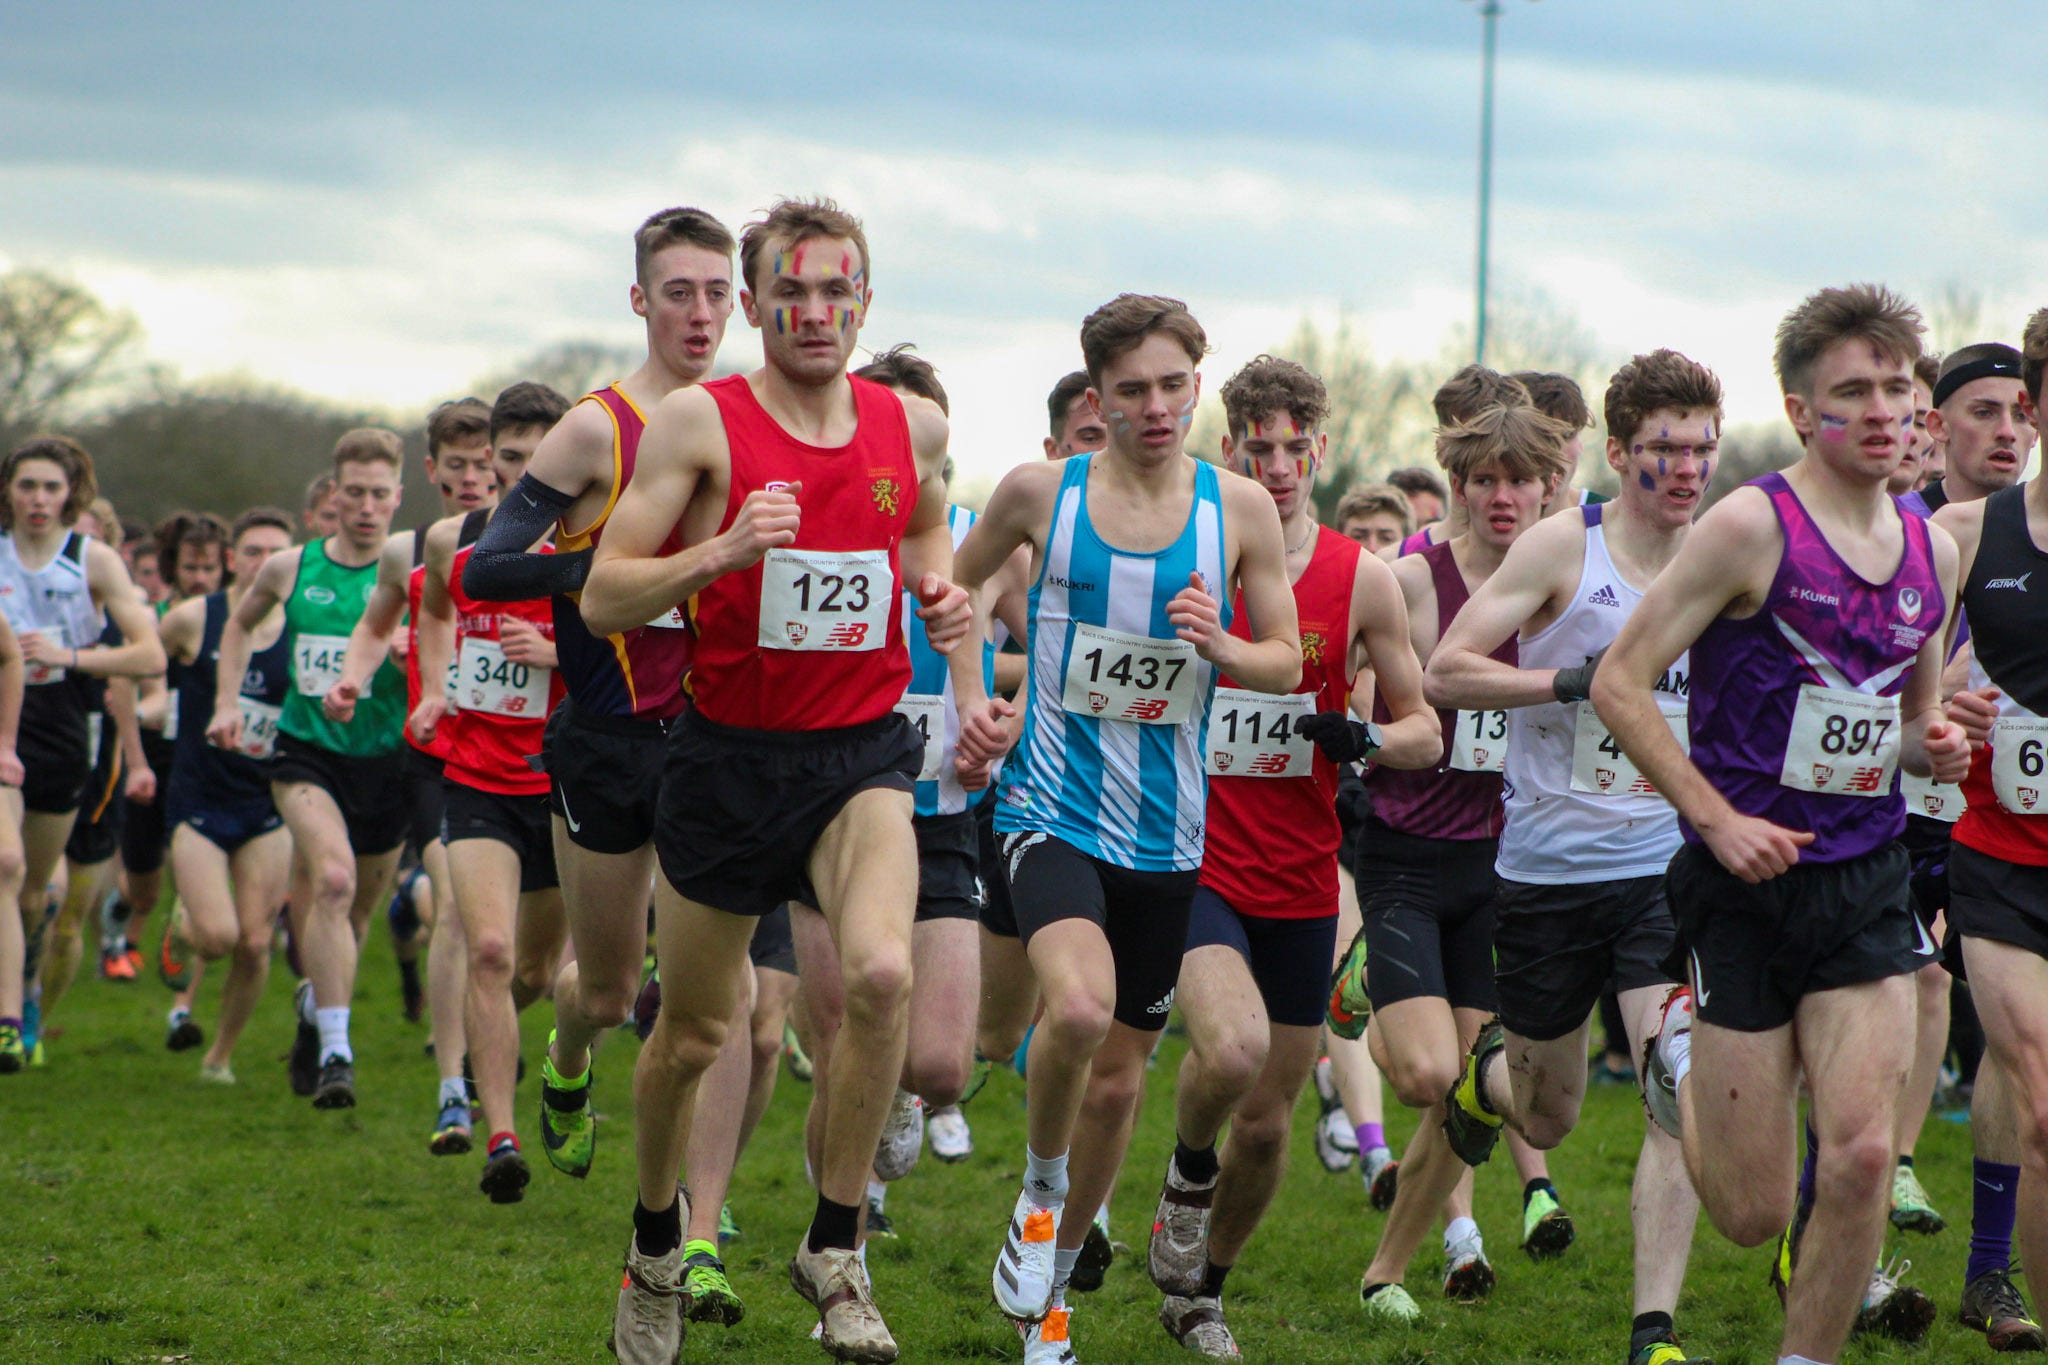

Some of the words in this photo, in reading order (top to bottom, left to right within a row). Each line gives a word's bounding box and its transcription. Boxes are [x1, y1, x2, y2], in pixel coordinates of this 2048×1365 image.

[793, 573, 870, 612] 123
[1056, 578, 1095, 592] KUKRI
[1800, 588, 1840, 606] KUKRI
[1588, 596, 1620, 607] adidas
[1097, 634, 1115, 642] CROSS
[1116, 638, 1141, 648] COUNTRY
[301, 647, 345, 673] 145
[474, 656, 529, 689] 340
[1085, 647, 1187, 691] 1437
[1470, 710, 1507, 741] 13
[1821, 714, 1893, 756] 897
[2019, 740, 2048, 777] 6
